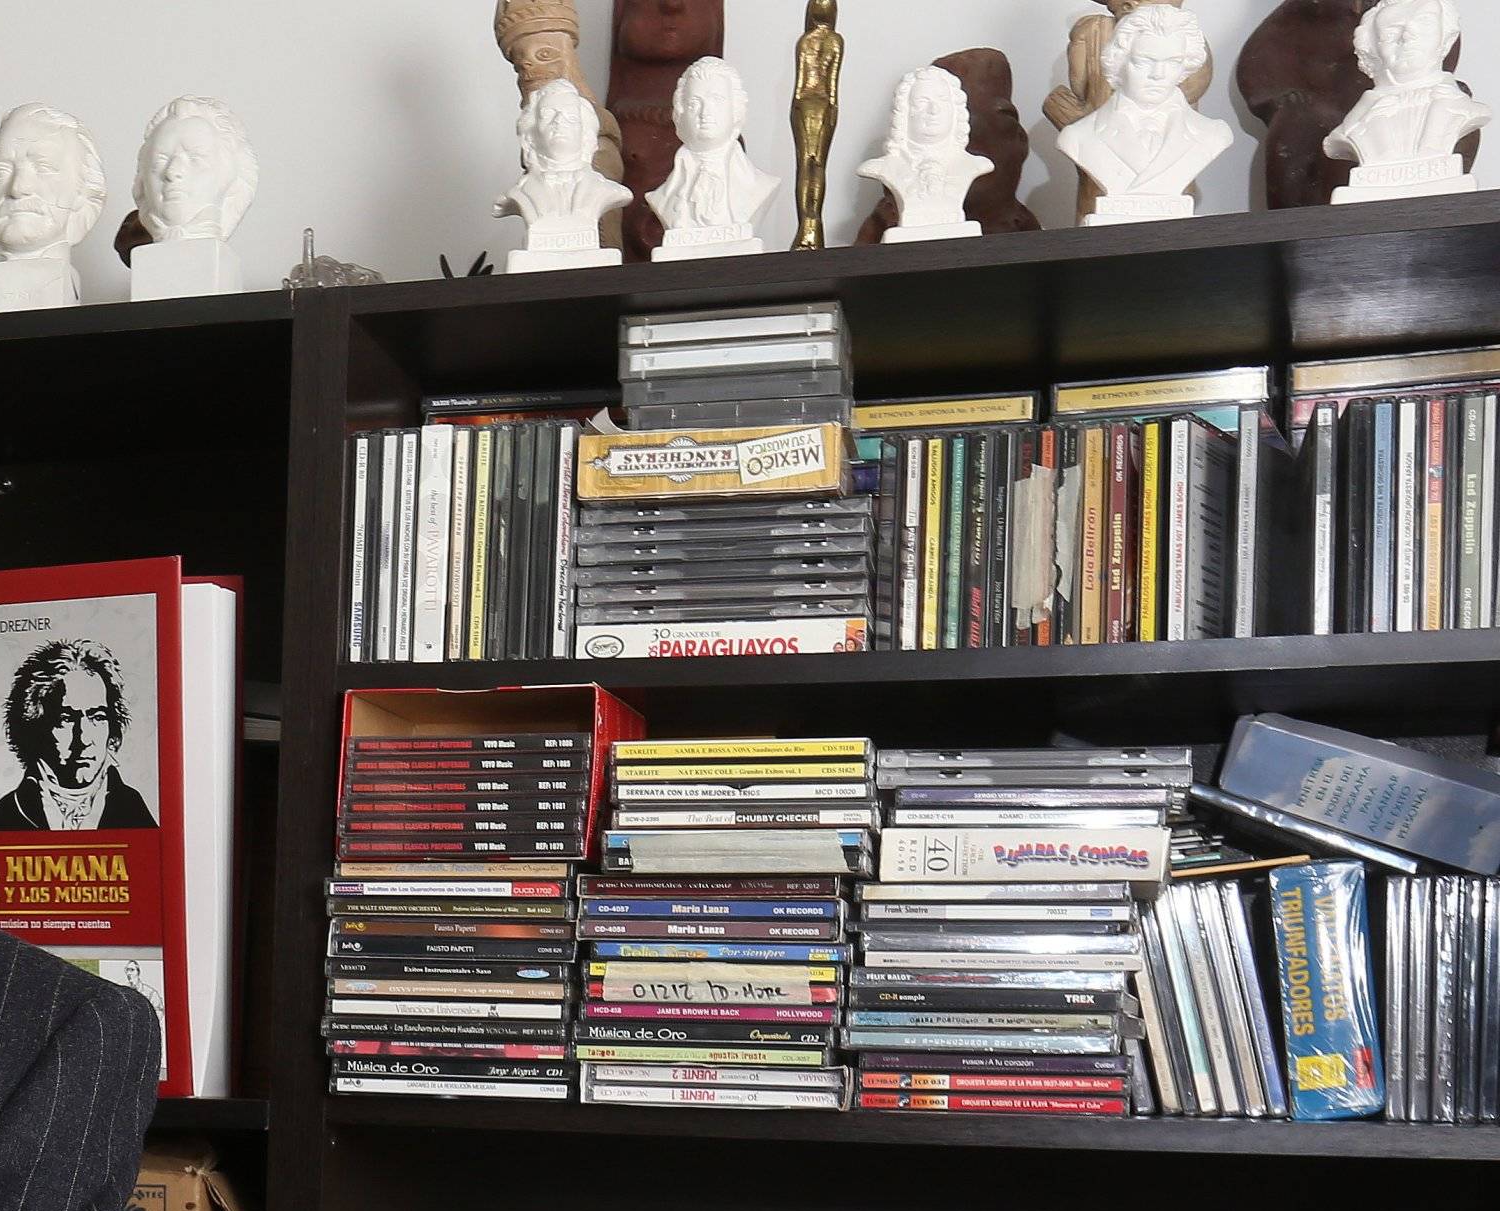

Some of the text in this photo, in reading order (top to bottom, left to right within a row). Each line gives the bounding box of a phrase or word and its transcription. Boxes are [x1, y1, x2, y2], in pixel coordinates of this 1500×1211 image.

[624, 450, 731, 464] RANCHERAS
[1468, 473, 1476, 503] Led
[1085, 507, 1096, 591] Lola Beltrán
[1111, 512, 1122, 591] Led Zeppelin
[0, 617, 51, 633] DREZNER
[353, 601, 363, 648] SAMSUNG
[651, 628, 670, 641] 30
[659, 637, 799, 658] PARAGUAYOS
[736, 814, 818, 822] CHUBBY CHECKER
[6, 855, 129, 882] HUMANA
[4, 887, 15, 903] Y
[20, 886, 49, 903] LOS
[55, 882, 129, 903] MÚSICOS
[671, 904, 824, 915] Mario Lanza OK RECORDS
[0, 918, 28, 928] música
[31, 920, 41, 928] no
[43, 918, 75, 931] siempre
[78, 919, 111, 929] cuentan
[668, 925, 820, 936] Mario Lanza OK RECORDS
[1278, 887, 1315, 1037] TRIUNFADORES
[1064, 994, 1095, 1004] TREX
[683, 1008, 709, 1016] BROWN
[776, 1010, 823, 1018] HOLLYWOOD
[588, 1026, 631, 1039] Música
[635, 1027, 653, 1040] de
[656, 1028, 687, 1040] Oro
[347, 1060, 387, 1072] Música
[391, 1062, 408, 1073] de
[412, 1063, 439, 1074] Oro
[672, 1069, 717, 1080] PUENTE 2
[677, 1089, 715, 1101] PUENTE
